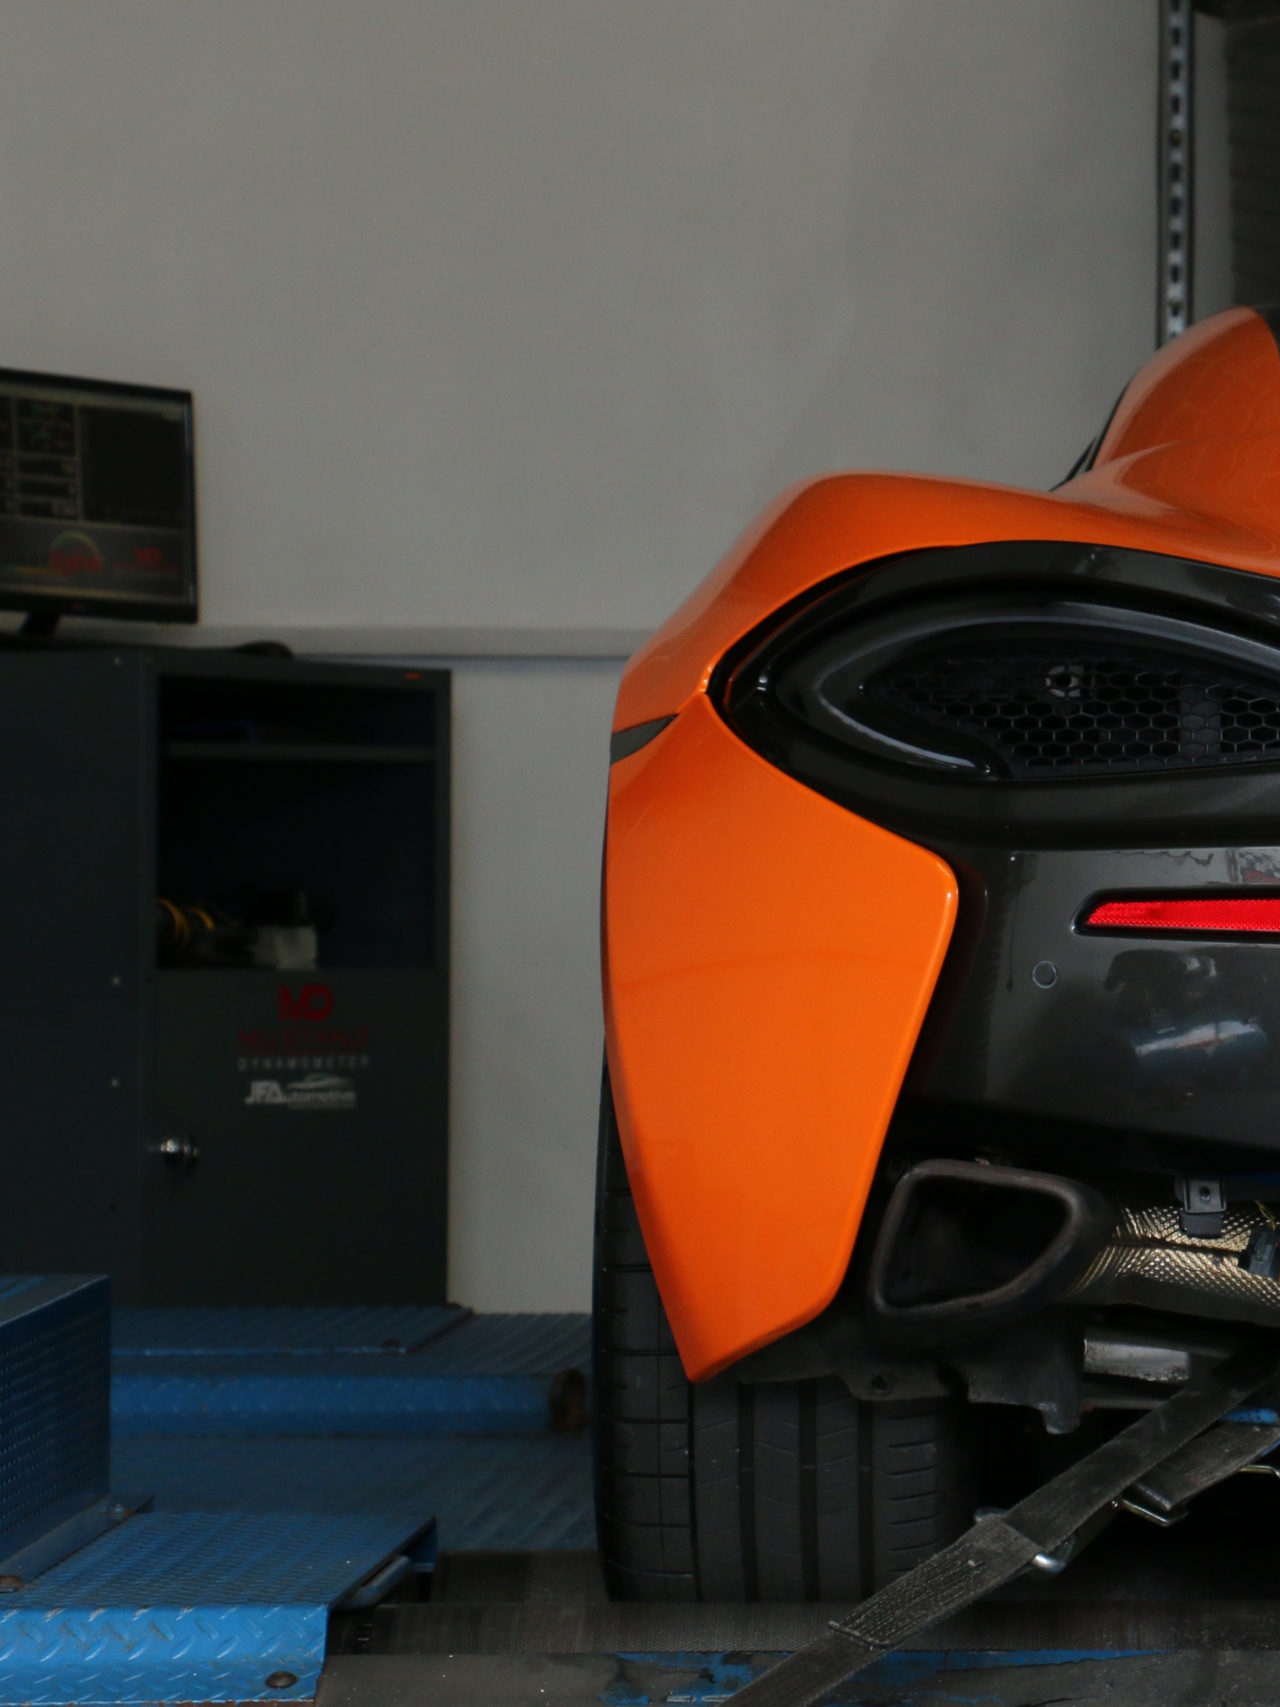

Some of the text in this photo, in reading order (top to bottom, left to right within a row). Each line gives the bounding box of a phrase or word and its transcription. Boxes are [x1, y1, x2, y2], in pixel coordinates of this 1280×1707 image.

[278, 984, 334, 1021] MD
[239, 1028, 370, 1047] MUSTANG
[237, 1055, 370, 1071] DYNAMOMETER
